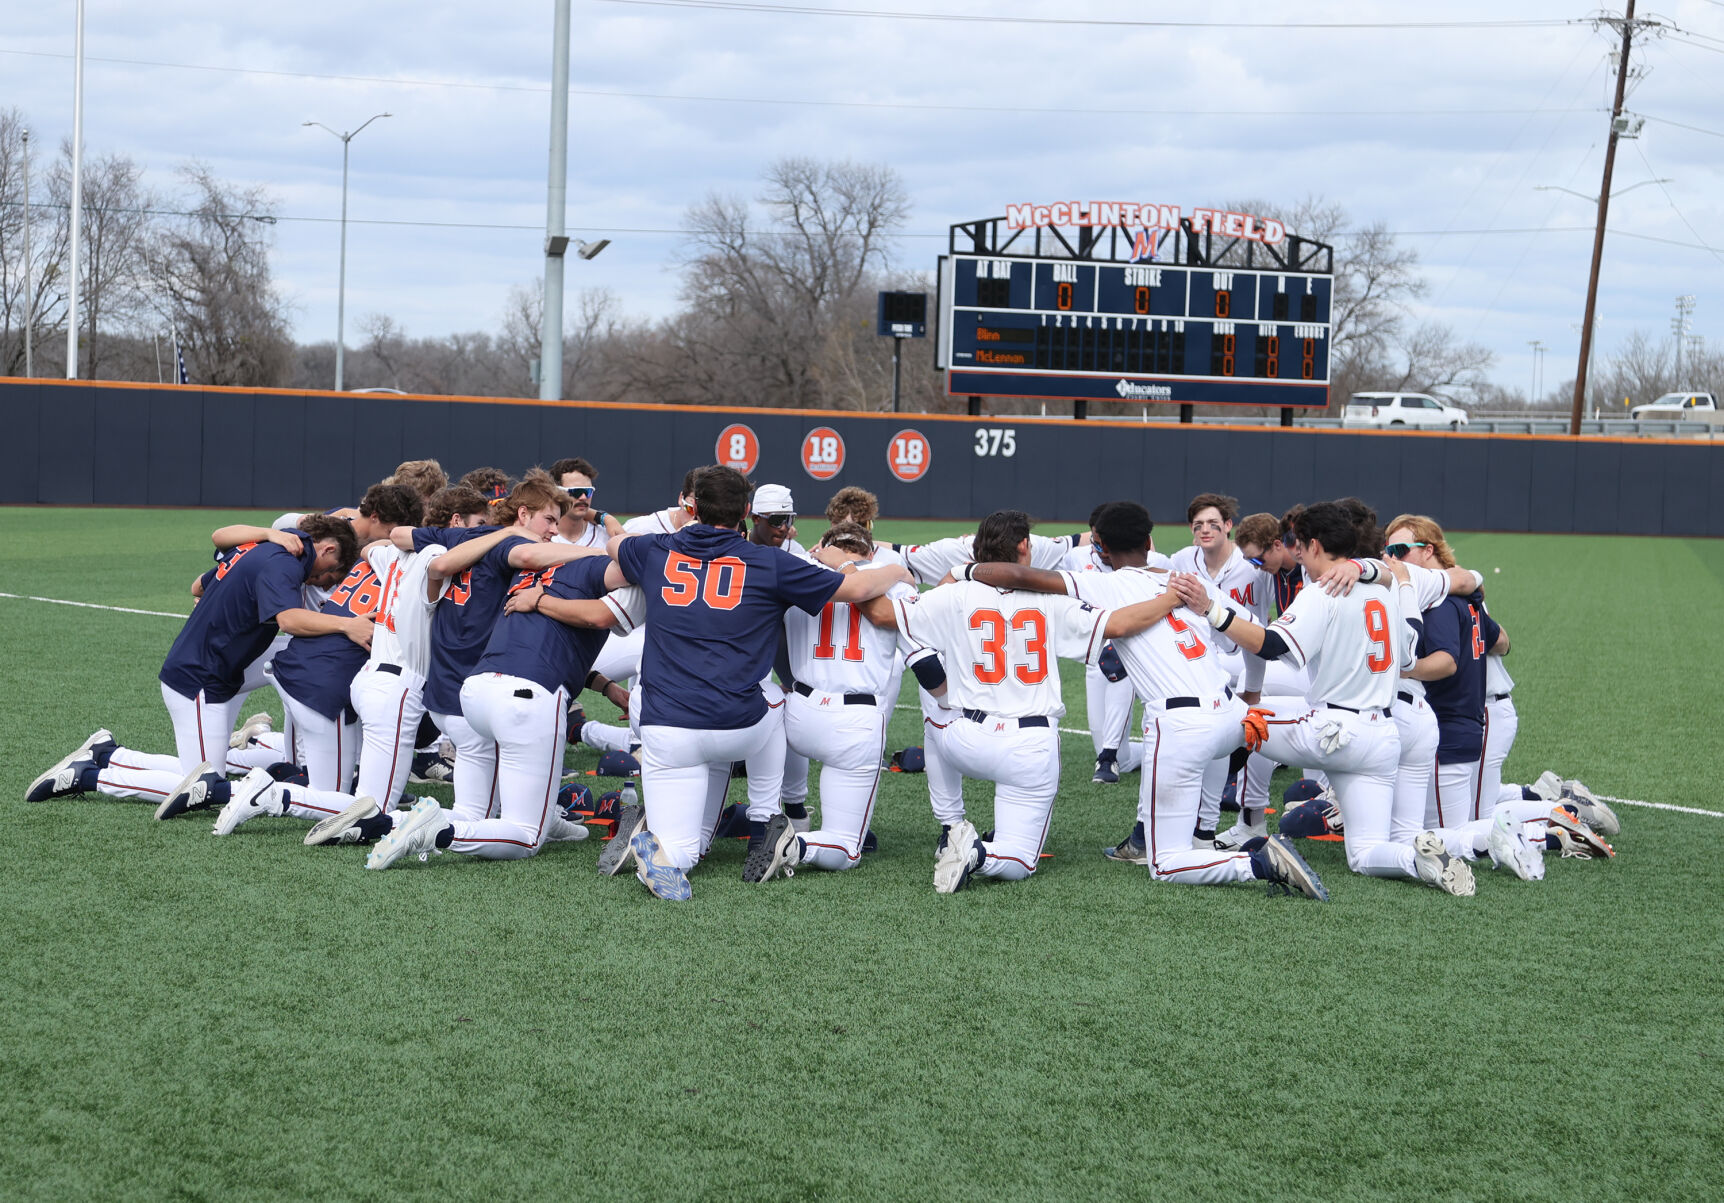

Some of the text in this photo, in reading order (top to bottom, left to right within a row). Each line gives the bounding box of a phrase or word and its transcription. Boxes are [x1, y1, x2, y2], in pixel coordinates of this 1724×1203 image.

[1006, 201, 1286, 244] McCLINTON FIELD
[1130, 229, 1161, 264] M
[976, 259, 1012, 280] AT BAT
[1053, 264, 1078, 283] BALL
[1124, 267, 1162, 288] STRIKE
[1213, 272, 1234, 291] OUT
[1057, 283, 1073, 310] 0
[1135, 286, 1149, 314] 0
[1216, 290, 1230, 318] 0
[976, 349, 1025, 364] McLennan
[1223, 334, 1235, 355] 0
[1268, 336, 1279, 357] 0
[1303, 338, 1314, 358] 0
[1223, 355, 1235, 376] 0
[1267, 357, 1278, 378] 0
[1302, 359, 1313, 379] 0
[730, 434, 746, 460] 8
[809, 436, 838, 463] 18
[895, 438, 923, 464] 18
[974, 428, 1016, 457] 375
[328, 560, 382, 617] 26
[662, 550, 746, 610] 50
[813, 600, 865, 663] 11
[1364, 598, 1394, 674] 9
[968, 608, 1048, 686] 33
